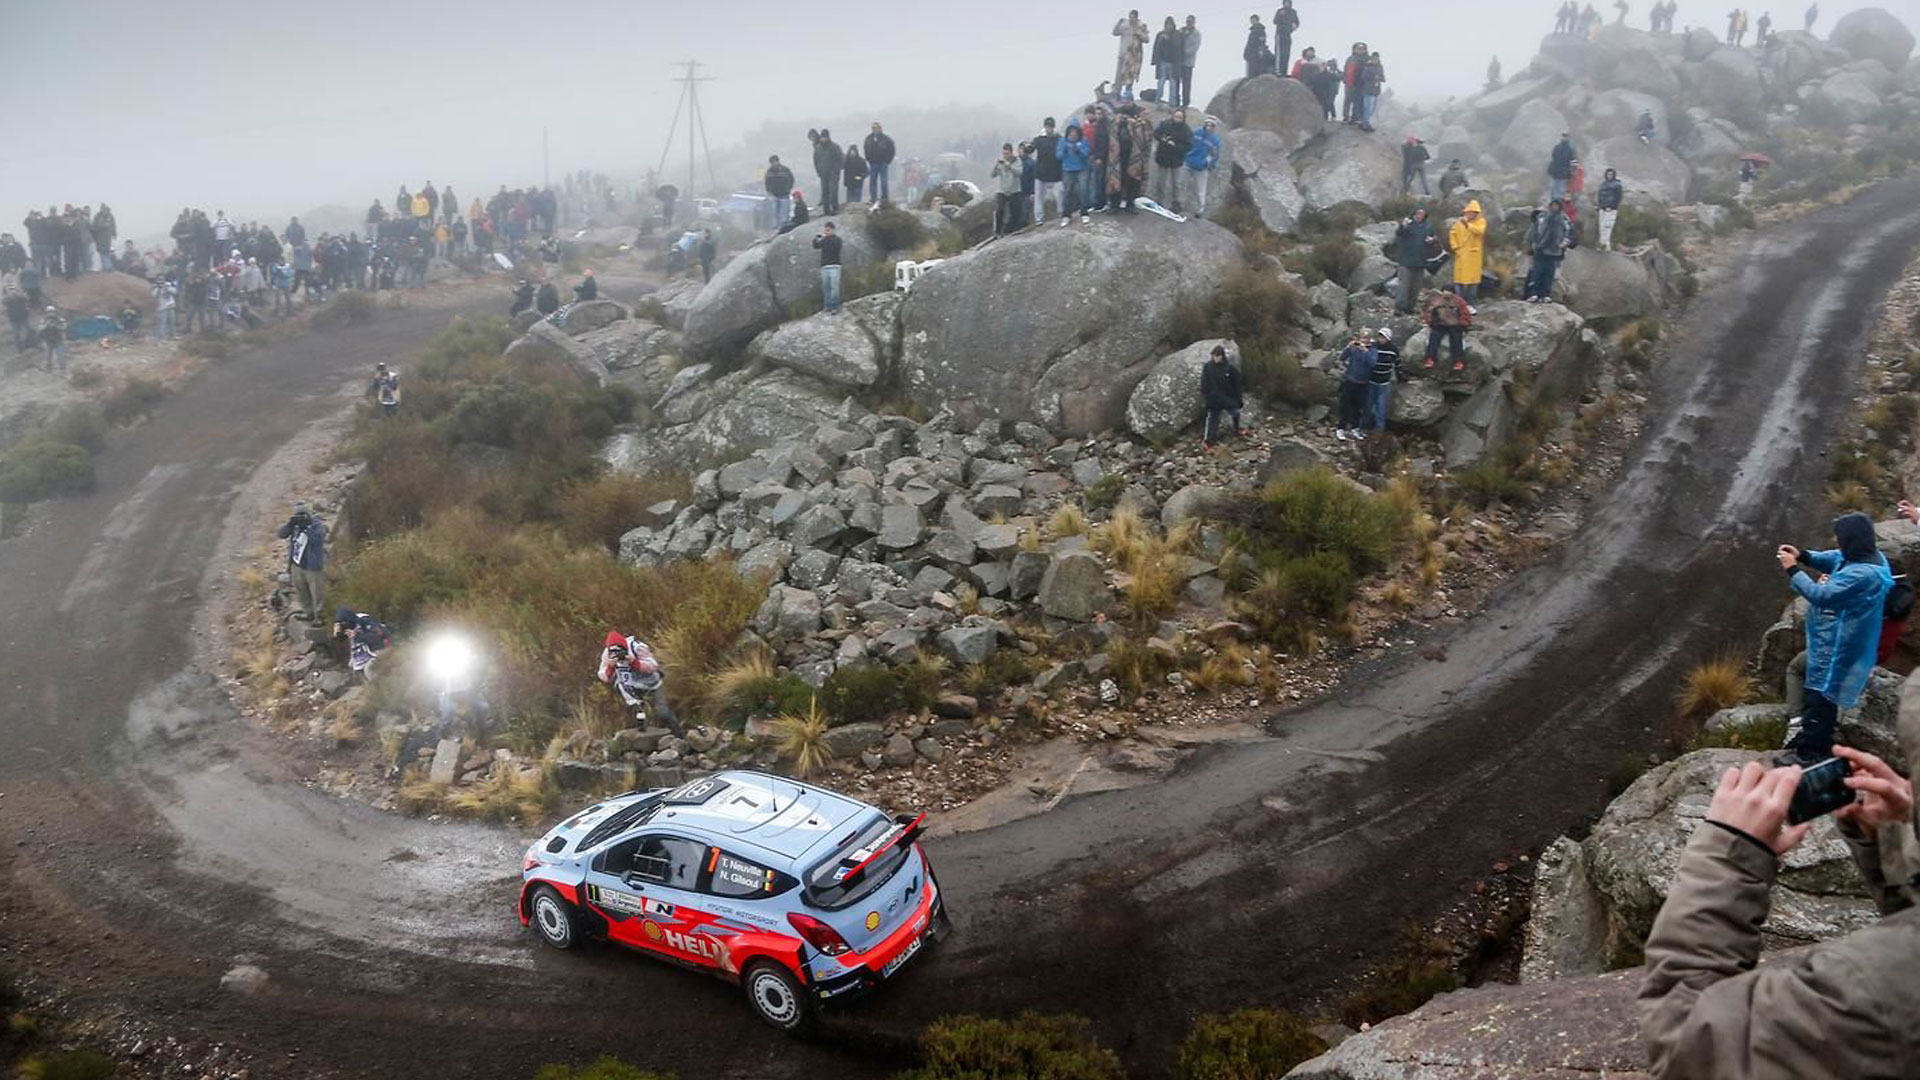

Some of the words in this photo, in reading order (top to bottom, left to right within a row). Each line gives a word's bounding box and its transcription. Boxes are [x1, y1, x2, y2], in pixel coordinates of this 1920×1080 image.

[729, 860, 763, 877] Neuville
[730, 873, 760, 889] Gilsoul
[655, 902, 675, 917] N
